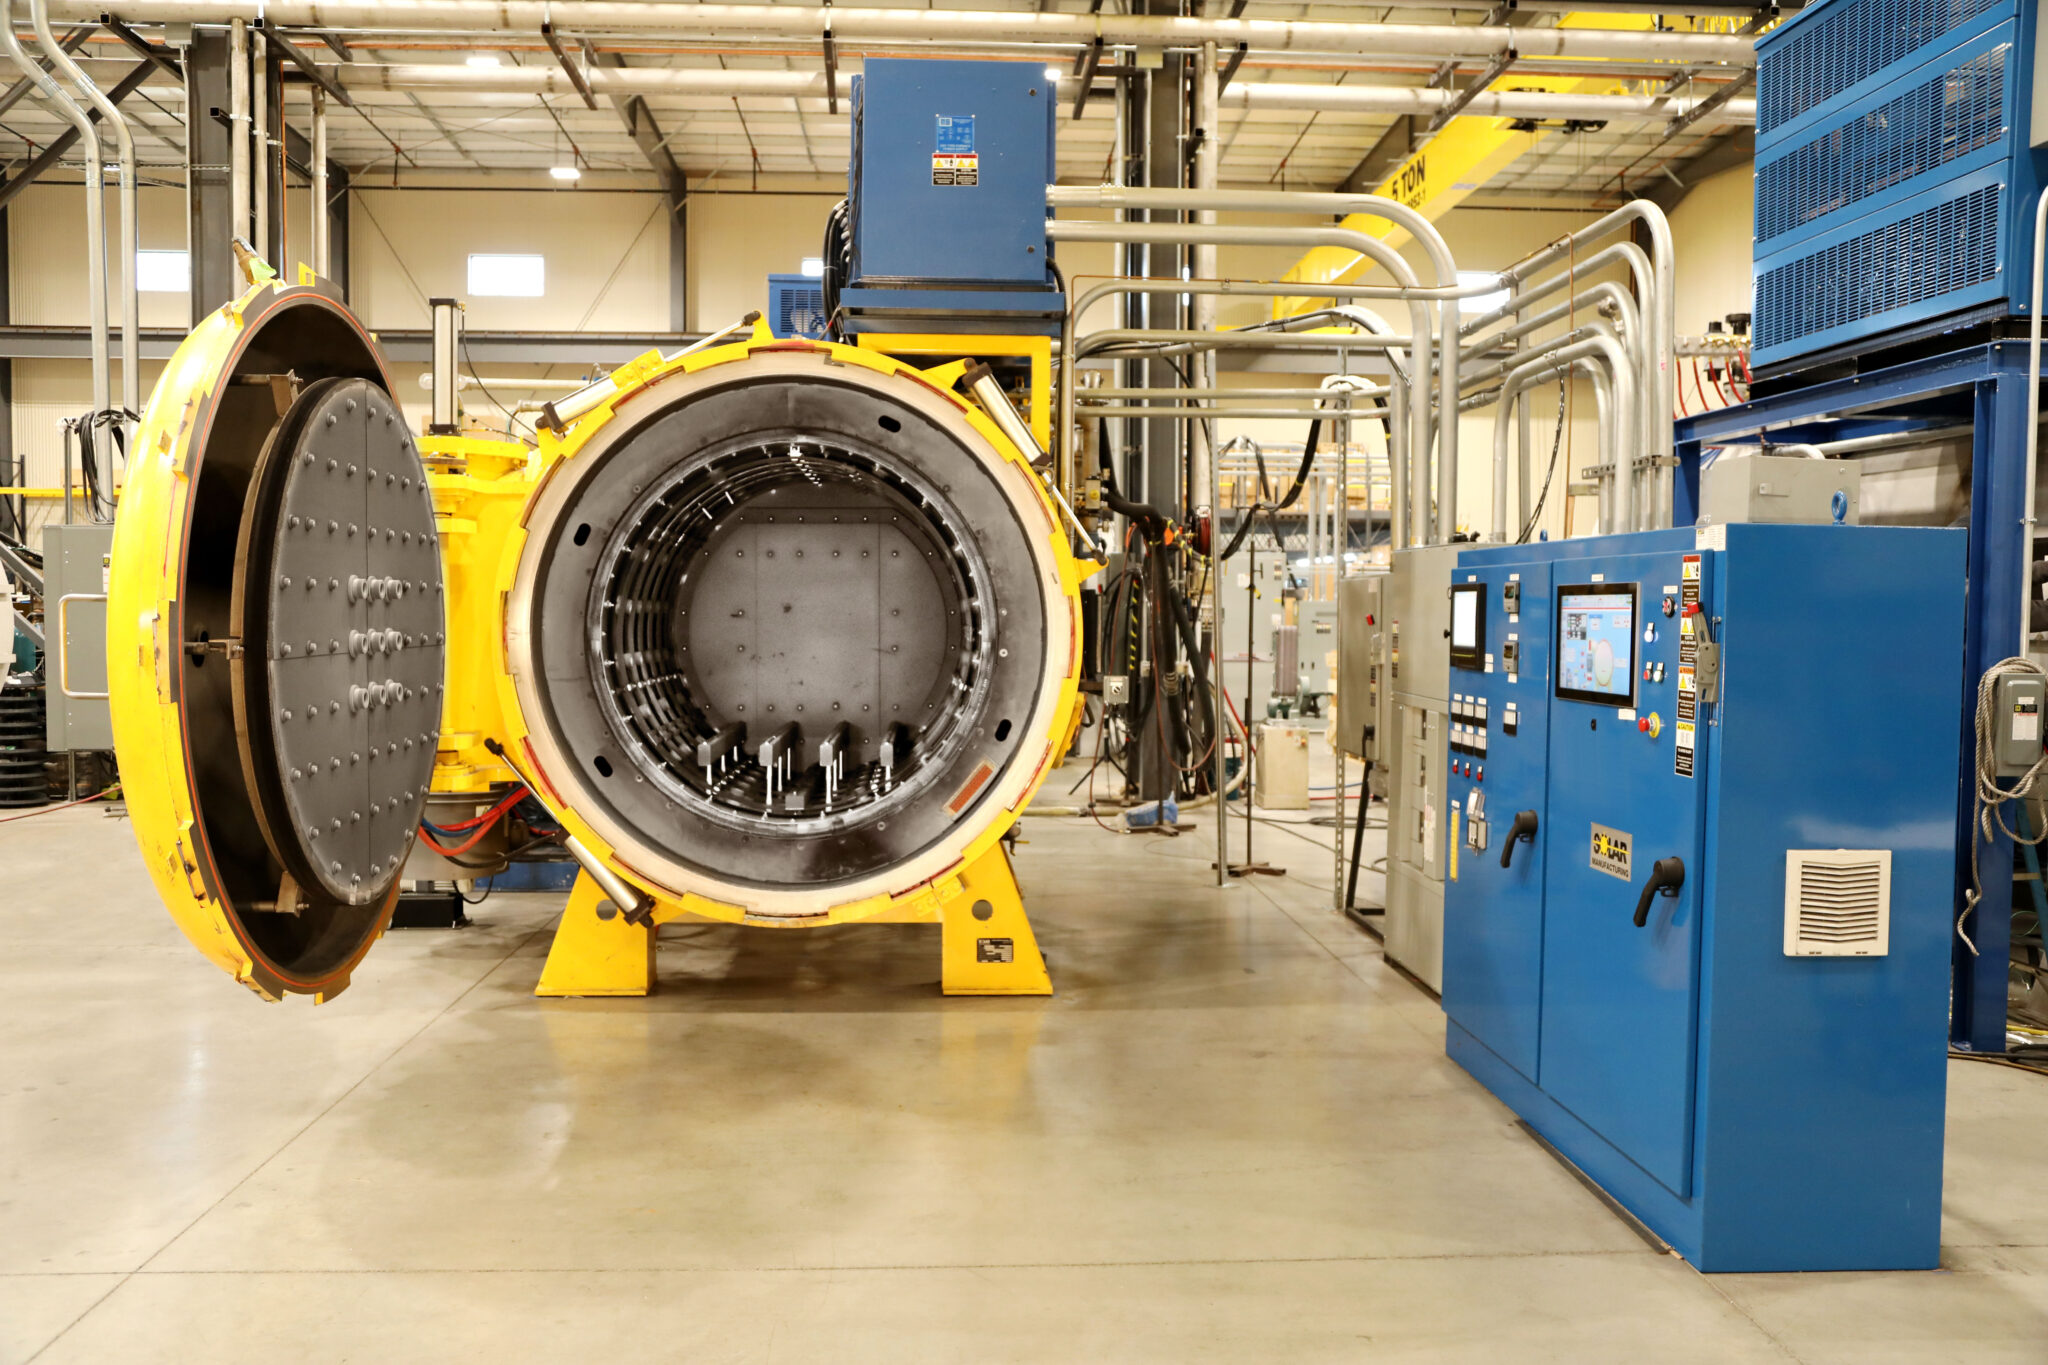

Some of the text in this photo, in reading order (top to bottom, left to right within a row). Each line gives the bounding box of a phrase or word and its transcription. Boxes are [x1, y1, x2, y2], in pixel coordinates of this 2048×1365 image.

[1392, 154, 1425, 201] 5 TON
[1592, 857, 1629, 878] MANUFACTURING
